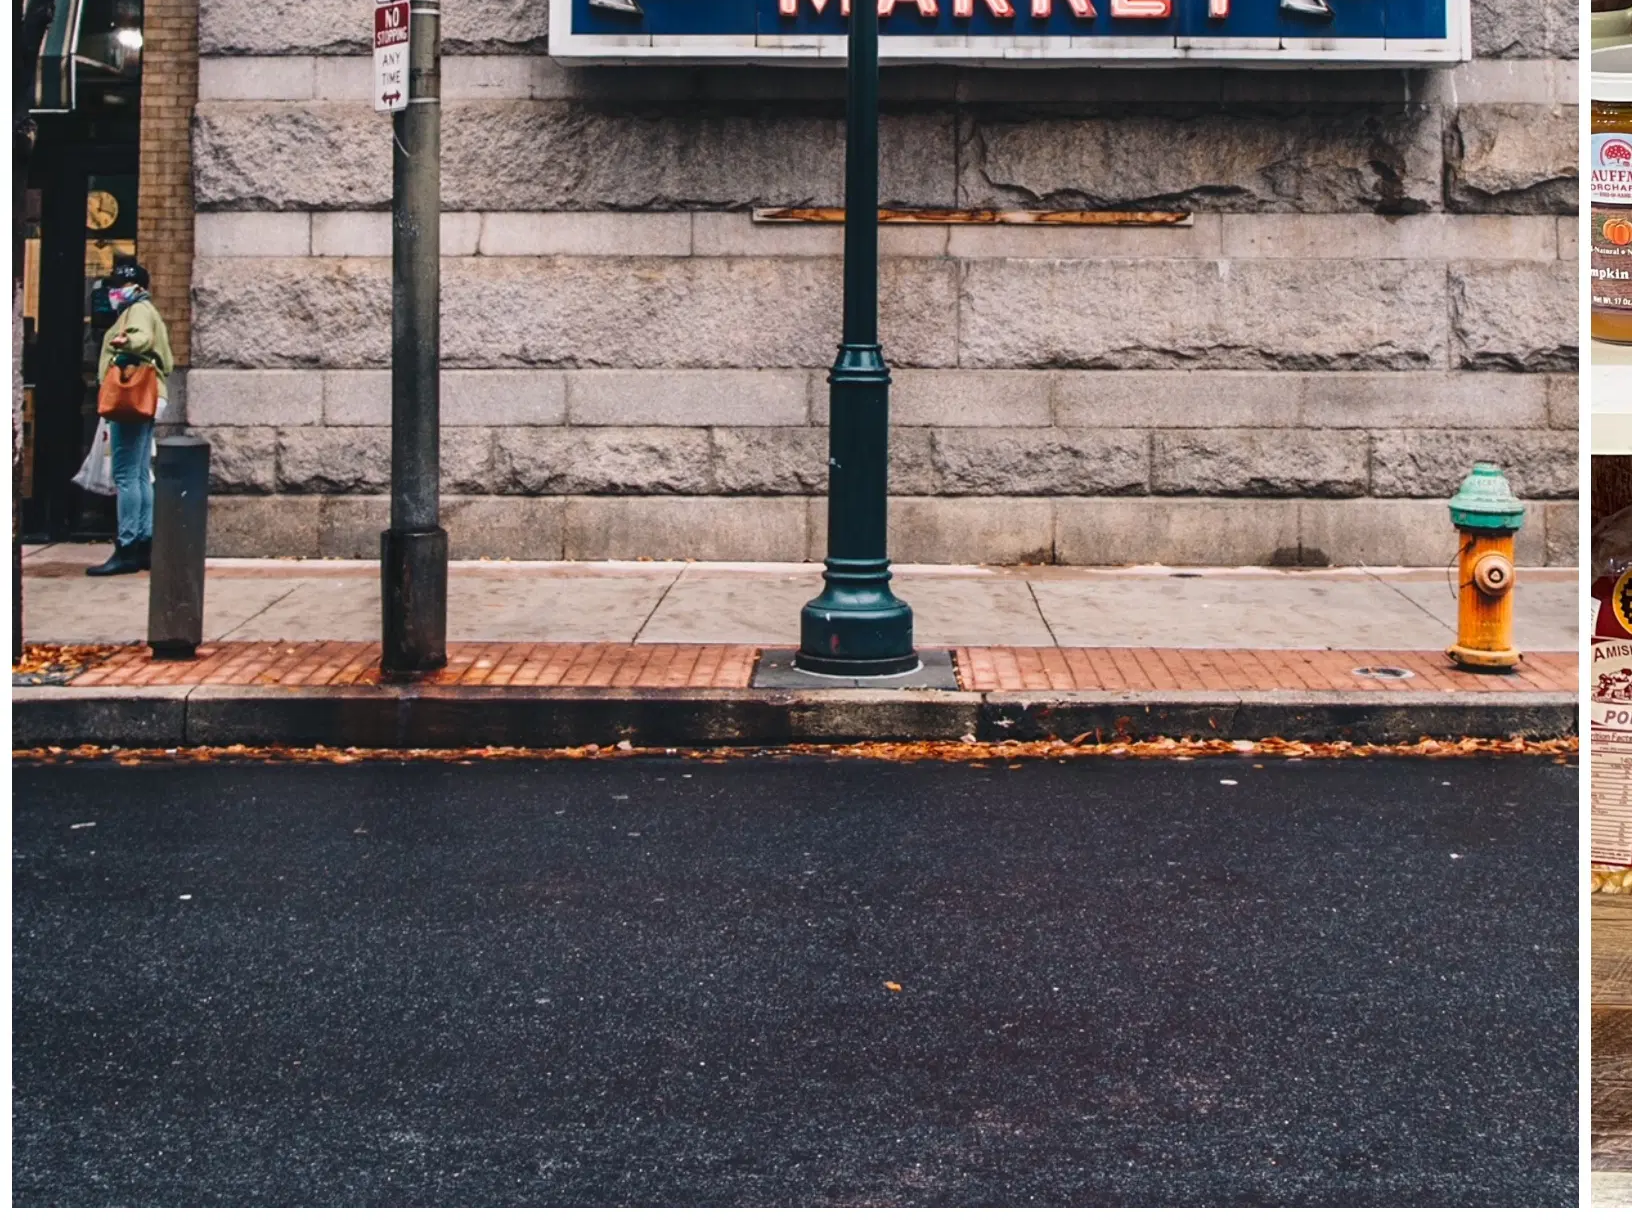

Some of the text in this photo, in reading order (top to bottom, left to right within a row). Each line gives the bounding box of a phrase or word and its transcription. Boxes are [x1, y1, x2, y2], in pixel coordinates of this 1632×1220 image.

[385, 7, 399, 28] NO
[377, 26, 407, 45] STOPPING
[382, 52, 401, 66] ANY
[382, 70, 401, 86] TIME
